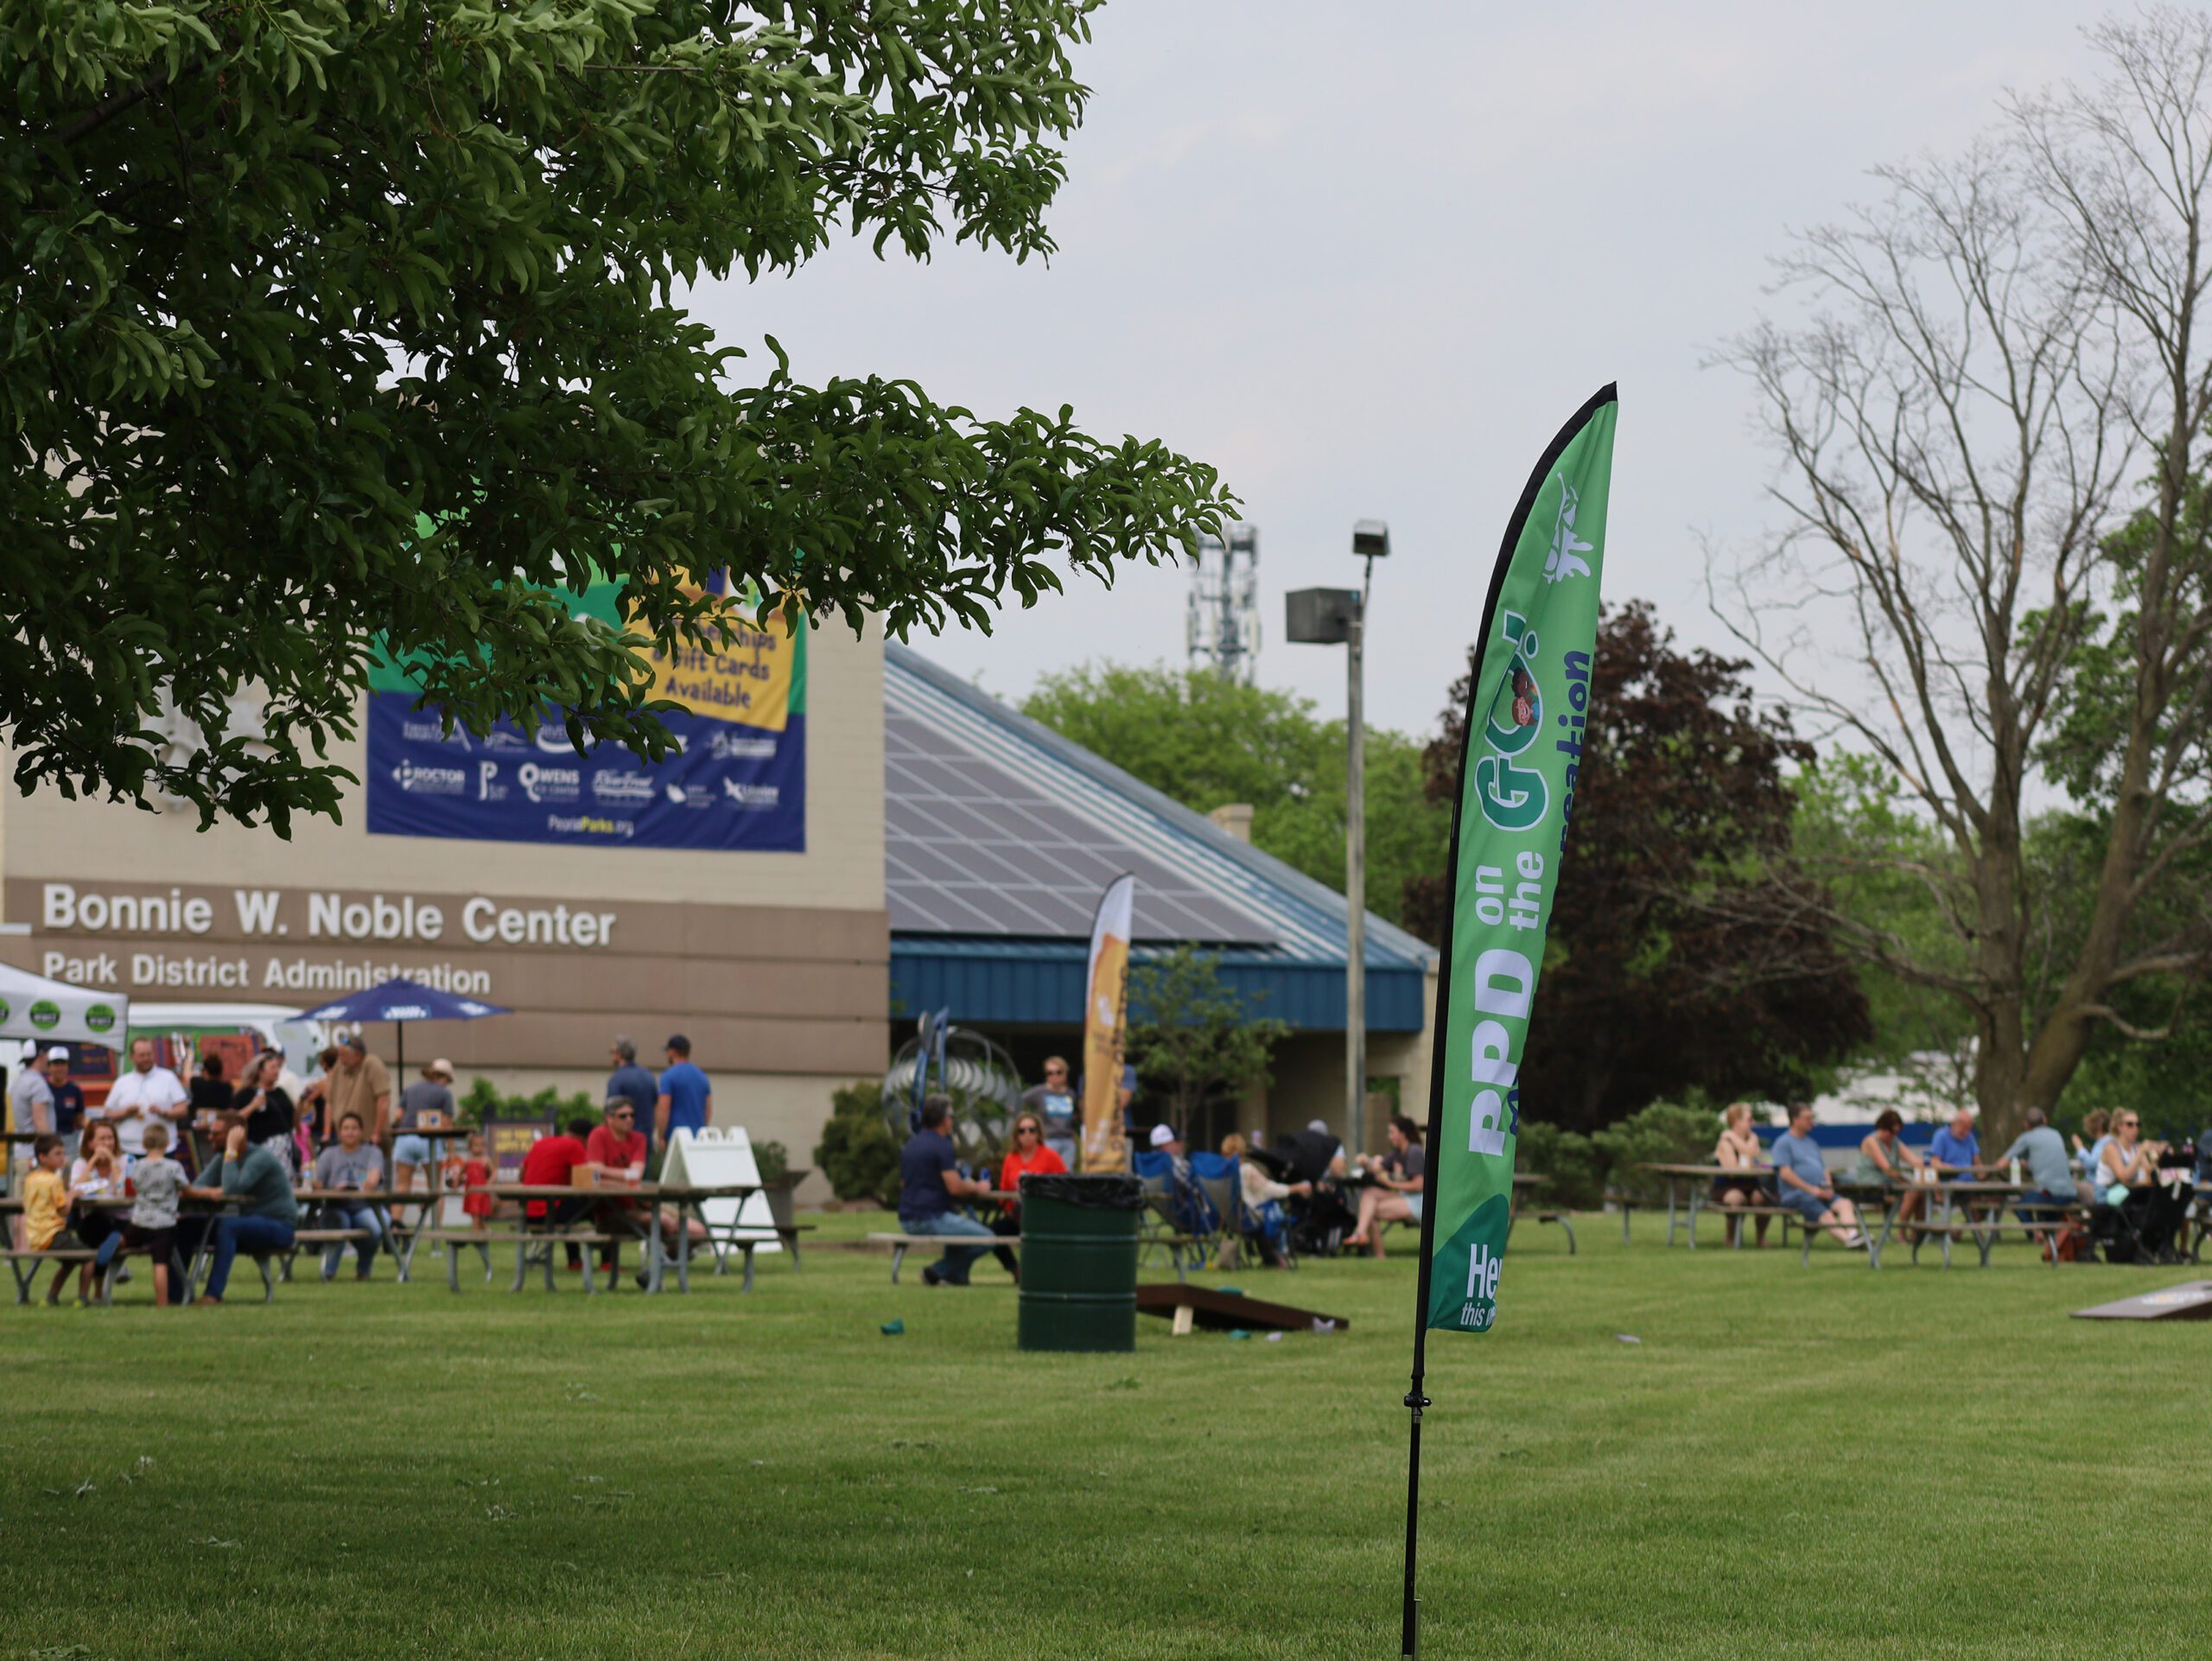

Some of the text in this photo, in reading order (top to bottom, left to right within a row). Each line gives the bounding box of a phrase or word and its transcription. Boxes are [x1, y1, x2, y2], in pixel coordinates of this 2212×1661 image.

[665, 677, 751, 709] Available
[715, 654, 770, 681] Cards
[44, 883, 615, 946] Bonnie W. Noble Center
[1475, 864, 1504, 926] on
[1509, 850, 1544, 932] the
[43, 951, 491, 996] Park District Administration
[1468, 948, 1534, 1156] PPD
[1466, 1243, 1503, 1301] He
[1460, 1301, 1485, 1327] this
